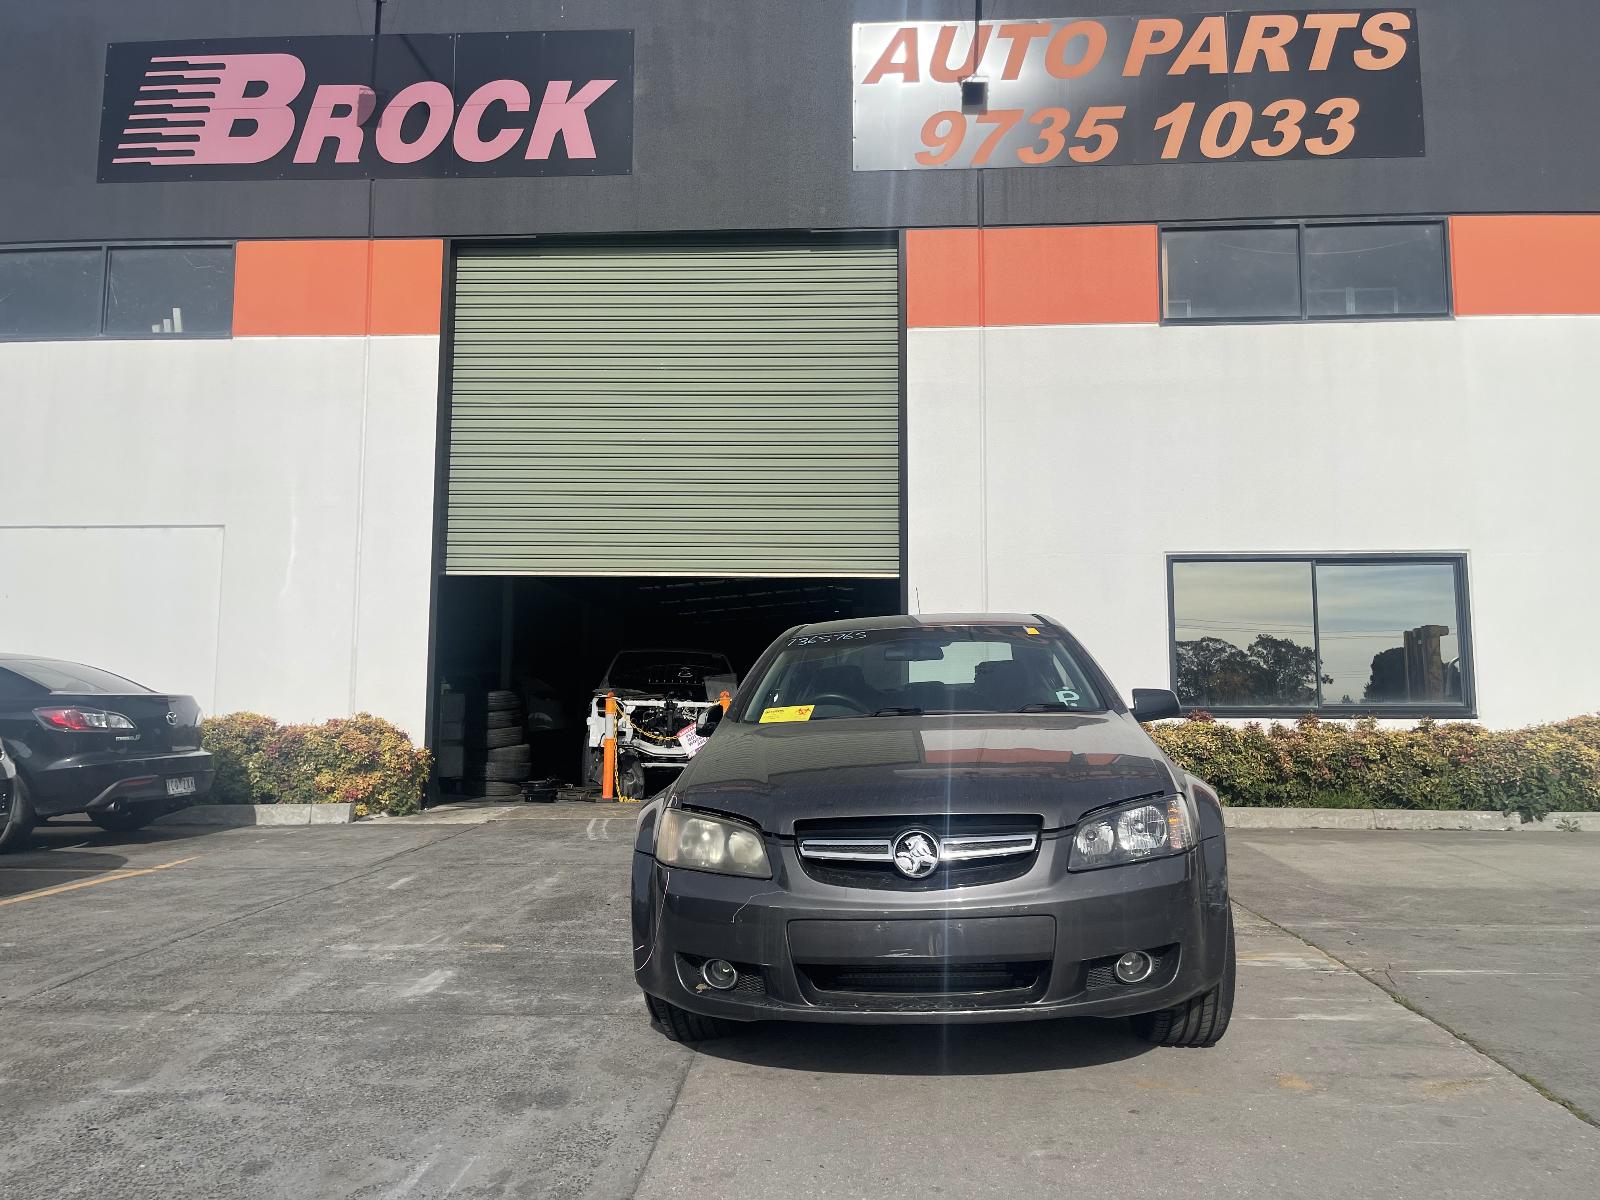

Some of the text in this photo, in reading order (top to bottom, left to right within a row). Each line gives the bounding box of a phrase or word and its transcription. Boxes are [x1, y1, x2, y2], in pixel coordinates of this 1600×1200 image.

[862, 11, 1411, 85] AUTO PARTS
[111, 52, 618, 165] BROCK
[914, 97, 1360, 166] 9735 1033
